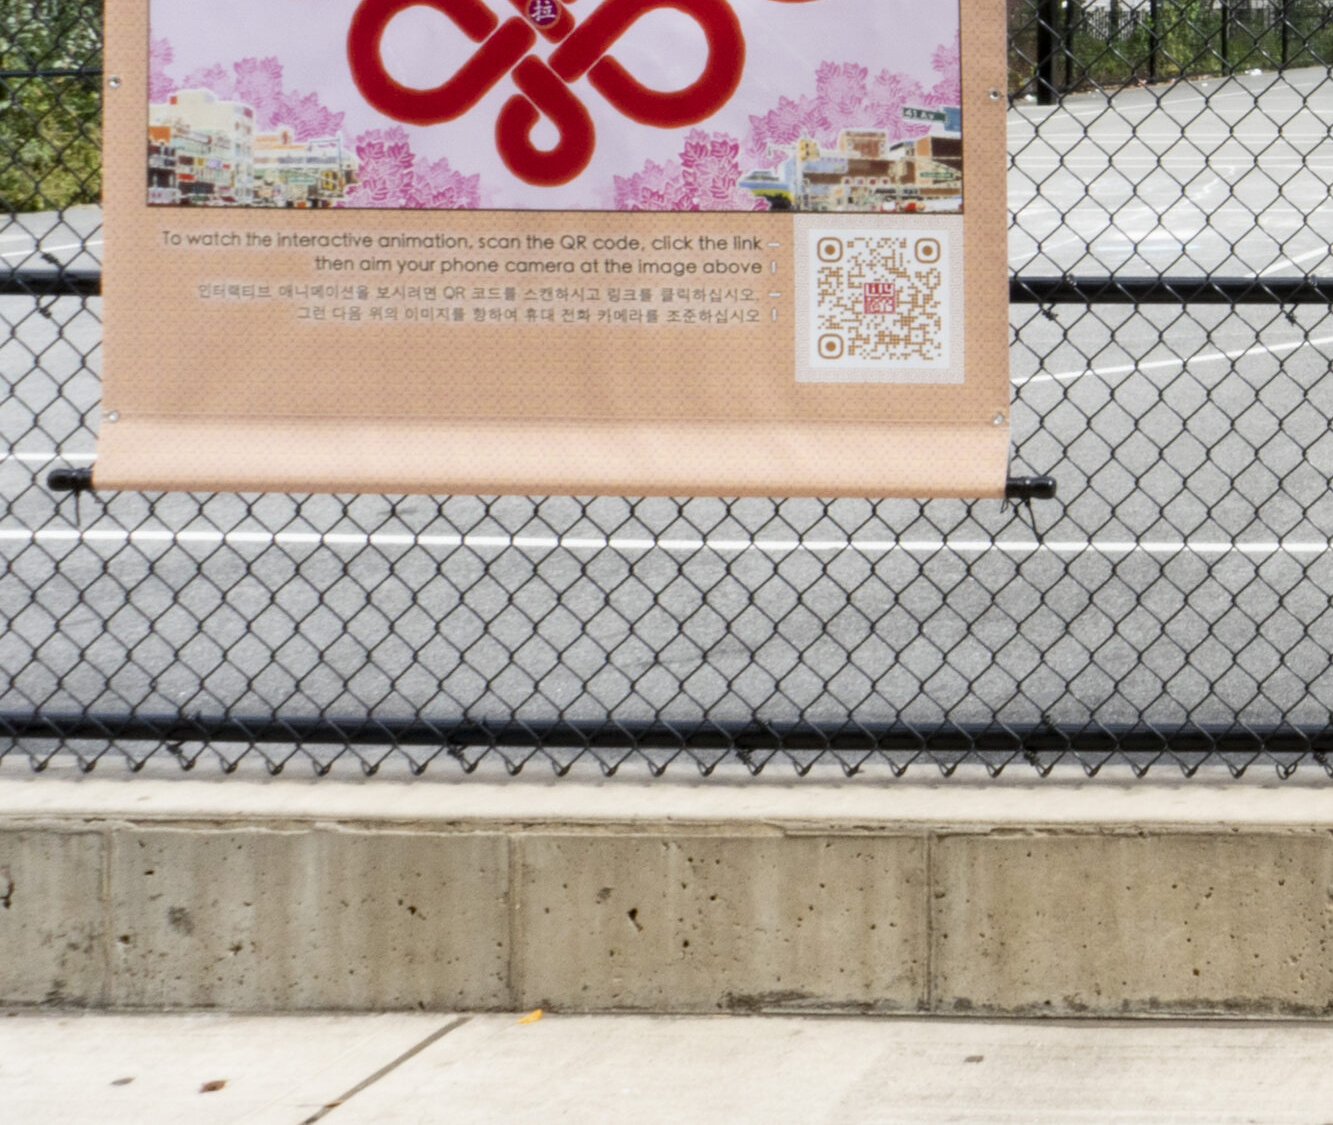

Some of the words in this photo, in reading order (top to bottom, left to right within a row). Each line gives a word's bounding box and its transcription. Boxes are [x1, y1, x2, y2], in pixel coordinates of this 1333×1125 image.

[162, 231, 181, 246] To
[187, 230, 241, 247] watch
[246, 230, 272, 247] the
[277, 231, 373, 248] interactive
[378, 231, 473, 251] animation,
[478, 235, 521, 250] scan
[526, 234, 555, 250] the
[560, 235, 587, 251] QR
[592, 235, 646, 253] code,
[651, 235, 693, 251] click
[699, 235, 728, 251] the
[733, 235, 763, 251] link
[315, 256, 353, 271] then
[359, 256, 392, 271] aim
[397, 260, 435, 275] your
[441, 257, 498, 275] phone
[505, 260, 574, 273] camera
[580, 258, 599, 273] at
[604, 257, 632, 273] the
[638, 258, 697, 276] image
[703, 258, 763, 274] above
[443, 285, 466, 300] QR
